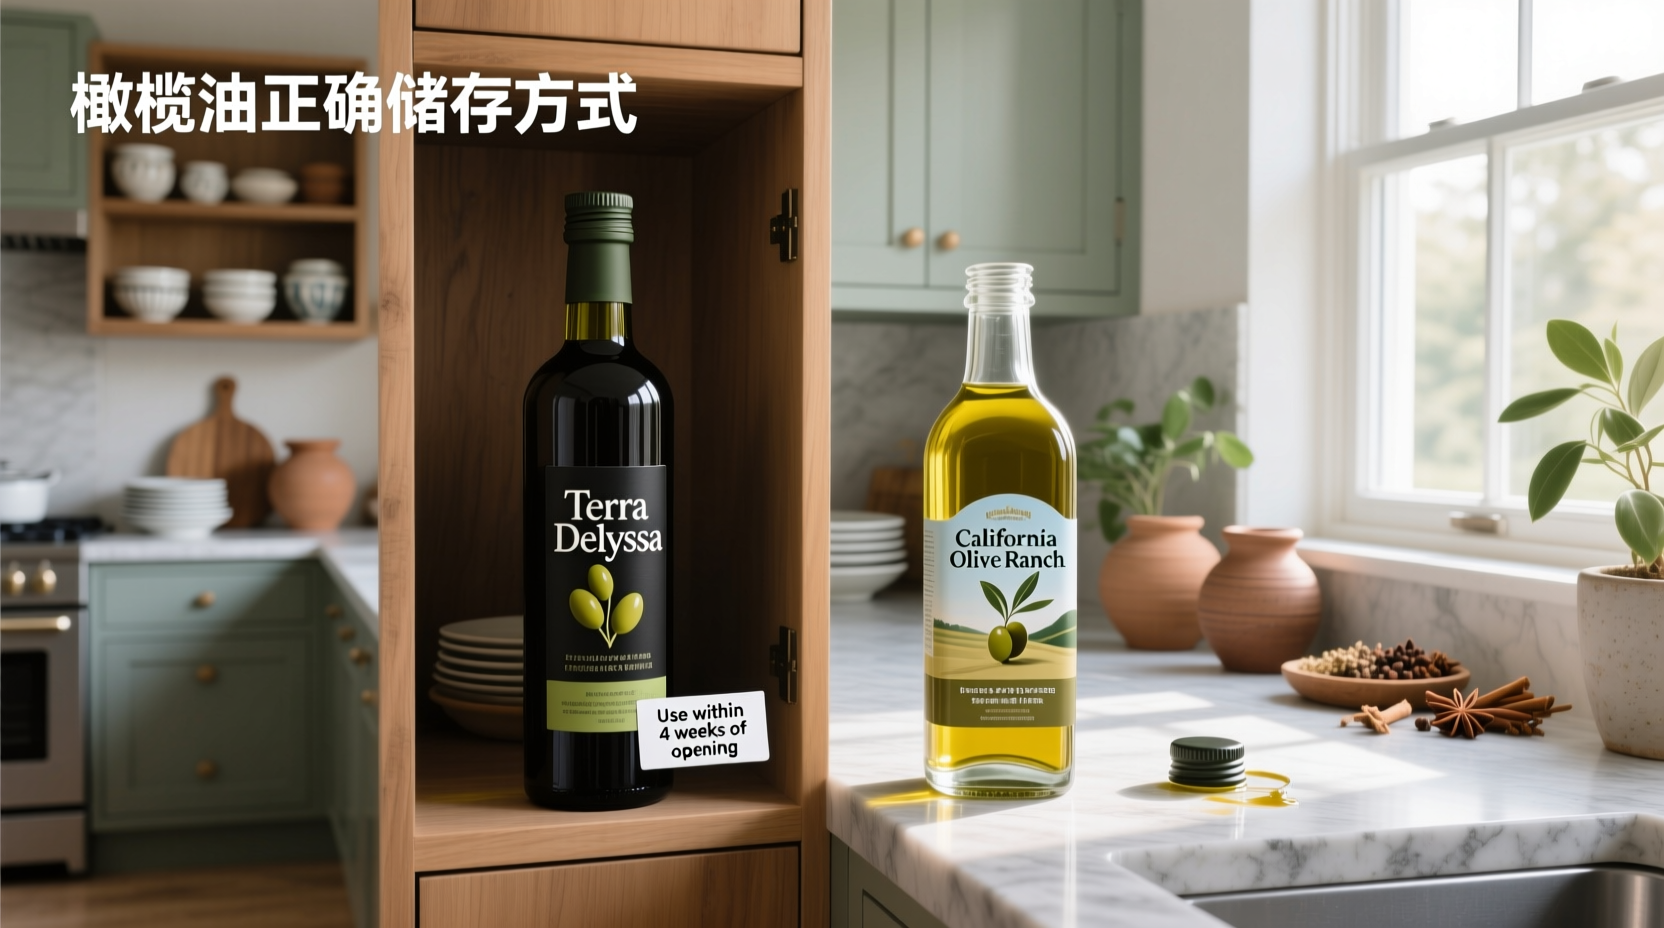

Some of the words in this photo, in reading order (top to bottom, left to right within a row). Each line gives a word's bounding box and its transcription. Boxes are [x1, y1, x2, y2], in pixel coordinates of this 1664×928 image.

[564, 489, 649, 521] Terra
[553, 522, 663, 562] Delyssa
[955, 527, 1057, 547] California
[949, 549, 1002, 569] Olive
[1004, 549, 1066, 569] Ranch
[657, 708, 688, 723] Use
[692, 702, 744, 720] within
[659, 726, 670, 741] 4
[674, 721, 726, 740] weeks
[729, 719, 747, 735] of
[671, 740, 738, 761] opening
